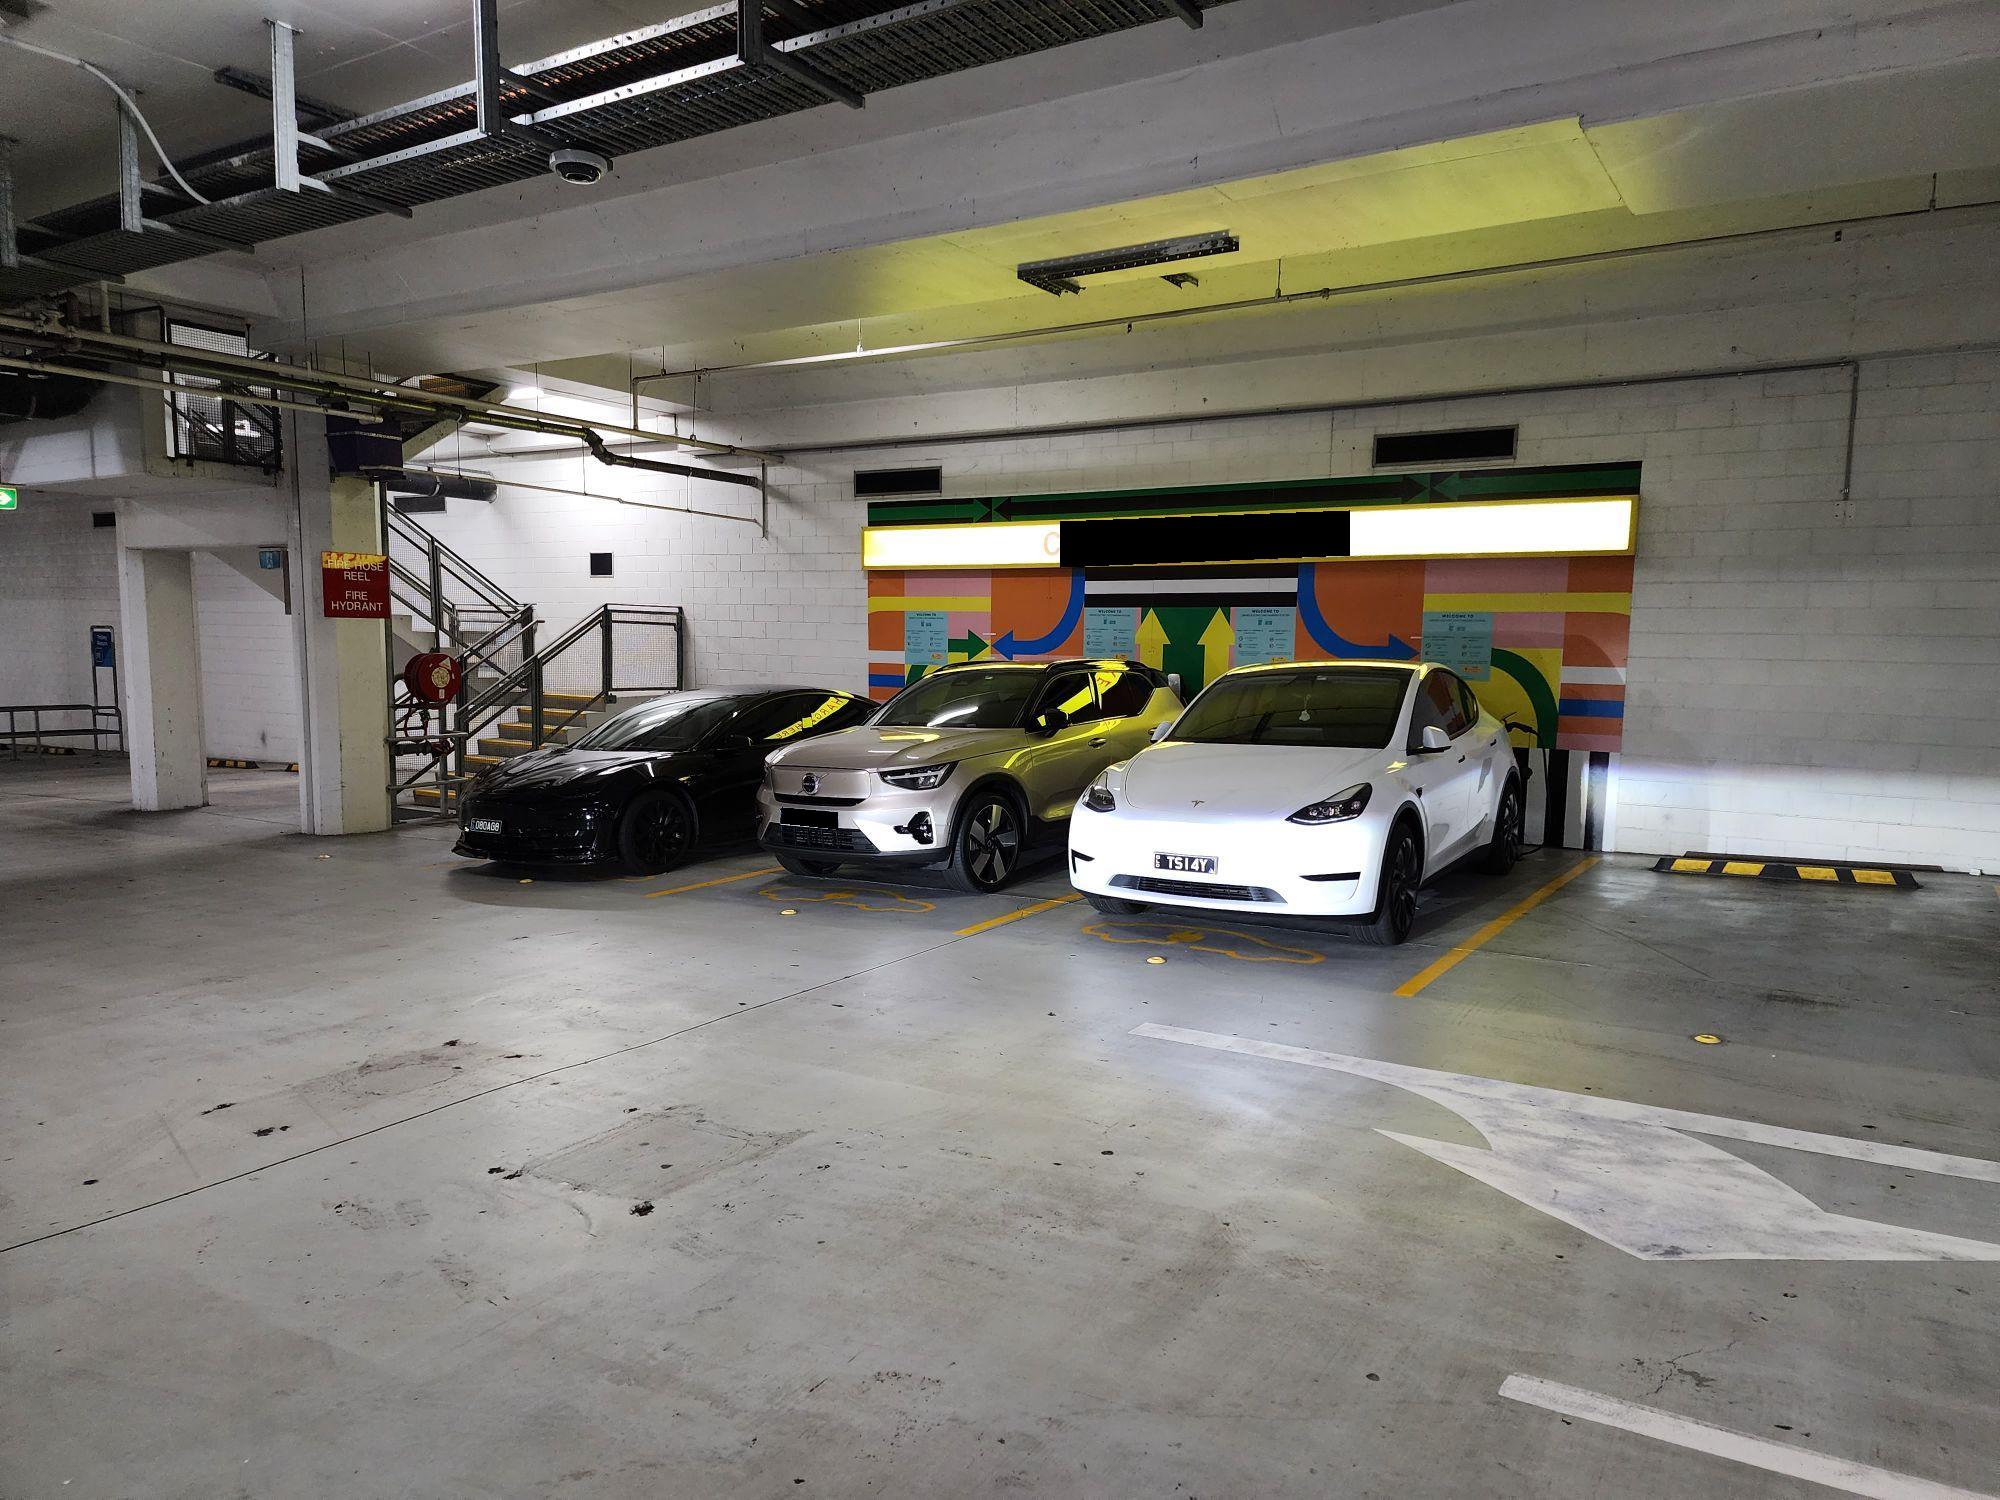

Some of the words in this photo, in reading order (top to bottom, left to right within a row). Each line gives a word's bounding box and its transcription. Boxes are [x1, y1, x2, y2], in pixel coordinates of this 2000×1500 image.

[327, 559, 351, 570] FIRE
[355, 562, 384, 572] HOSE
[343, 571, 371, 582] REEL
[345, 590, 368, 601] FIRE
[331, 600, 383, 612] HYDRANT
